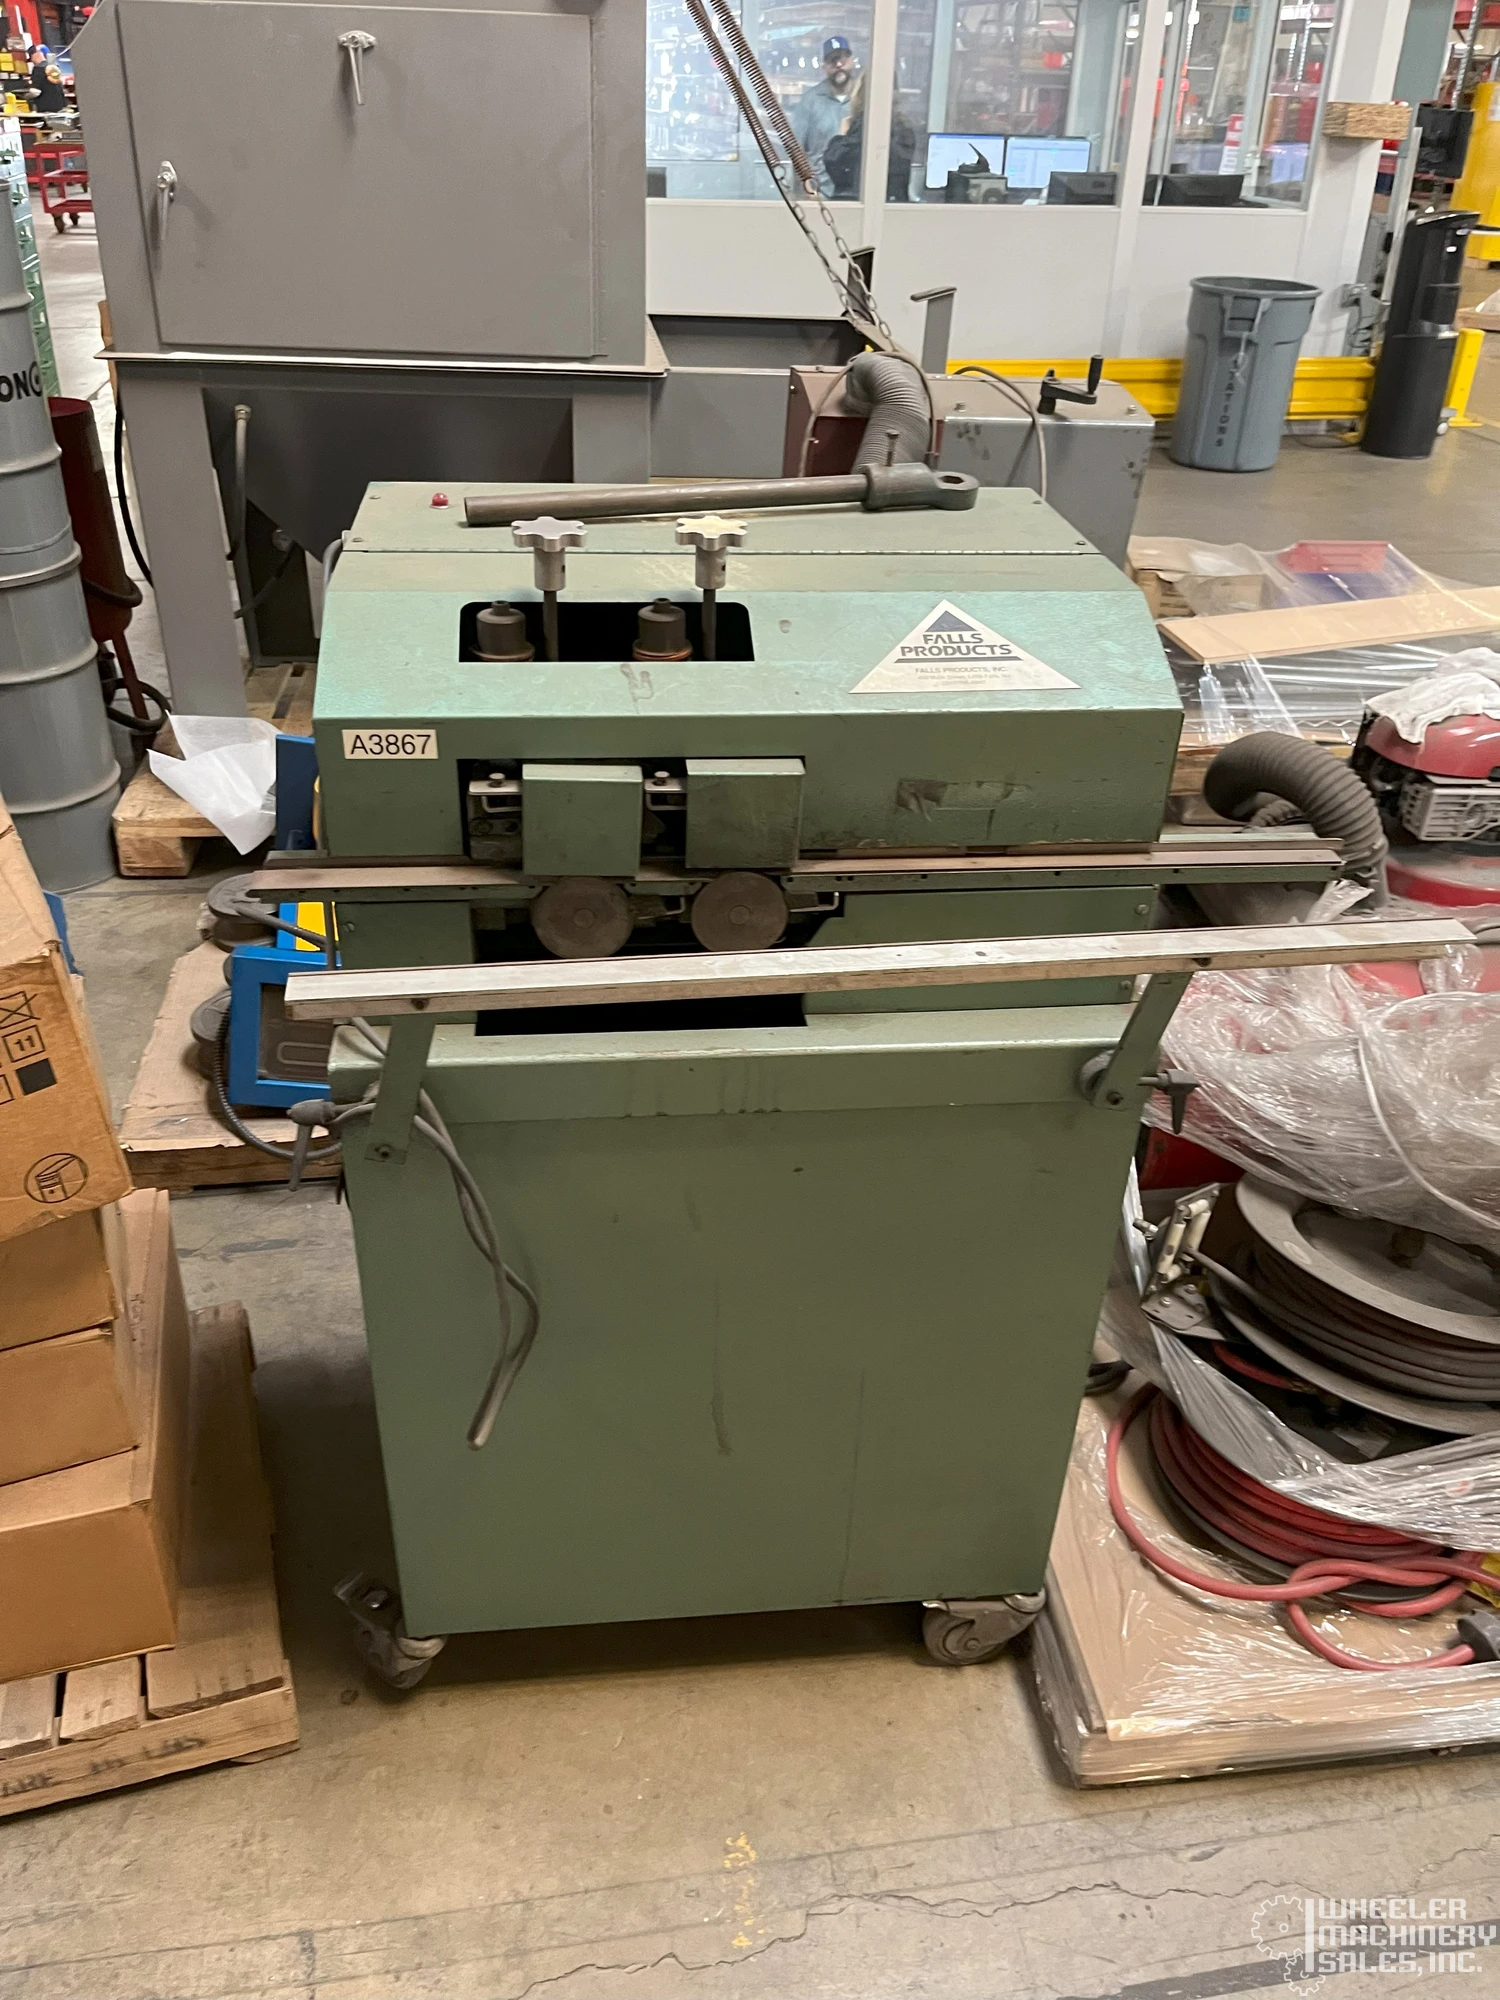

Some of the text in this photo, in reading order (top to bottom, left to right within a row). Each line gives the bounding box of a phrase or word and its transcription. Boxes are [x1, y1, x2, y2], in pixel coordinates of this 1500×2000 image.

[922, 633, 984, 645] FALLS
[900, 644, 1012, 657] PRODUCTS
[350, 734, 431, 755] A3867
[14, 1034, 35, 1051] 11
